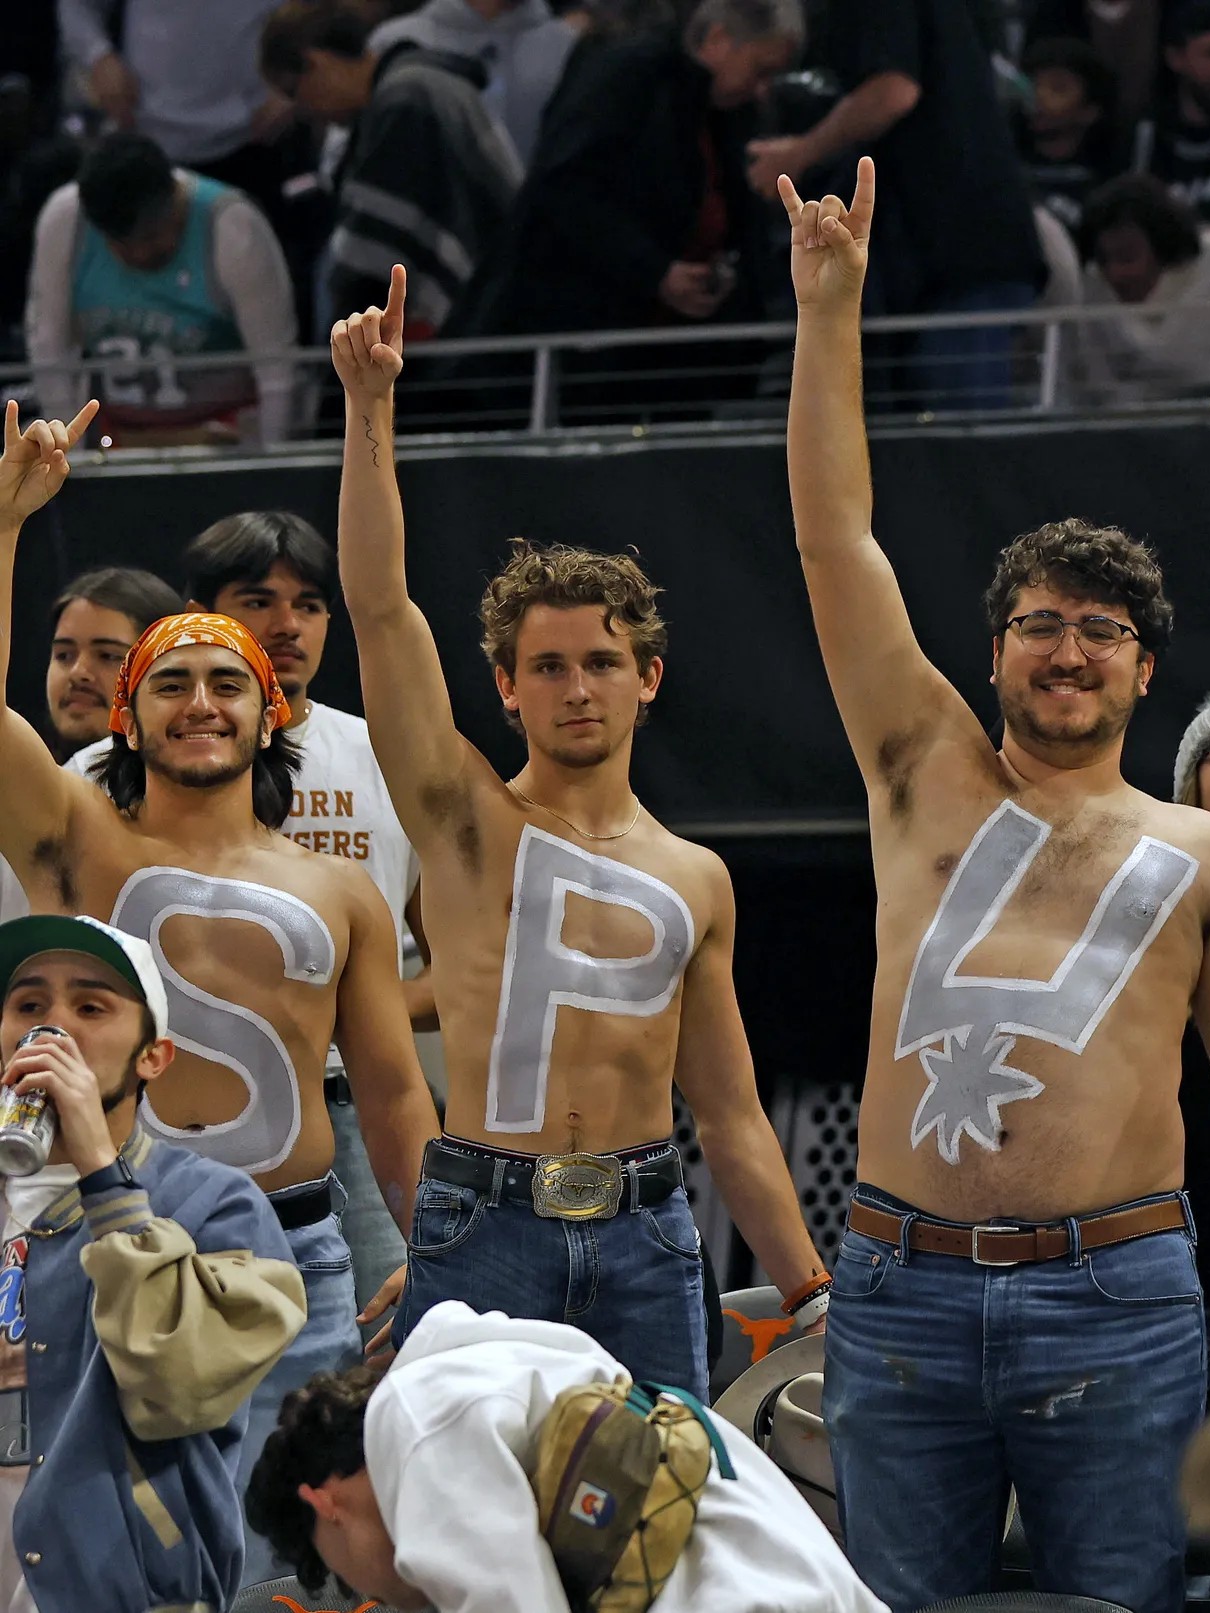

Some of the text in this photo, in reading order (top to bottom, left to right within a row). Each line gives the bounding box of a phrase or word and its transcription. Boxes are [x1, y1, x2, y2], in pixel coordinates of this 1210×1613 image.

[98, 336, 188, 409] 21
[109, 866, 336, 1175] S
[484, 824, 696, 1133] P
[894, 798, 1201, 1062] U
